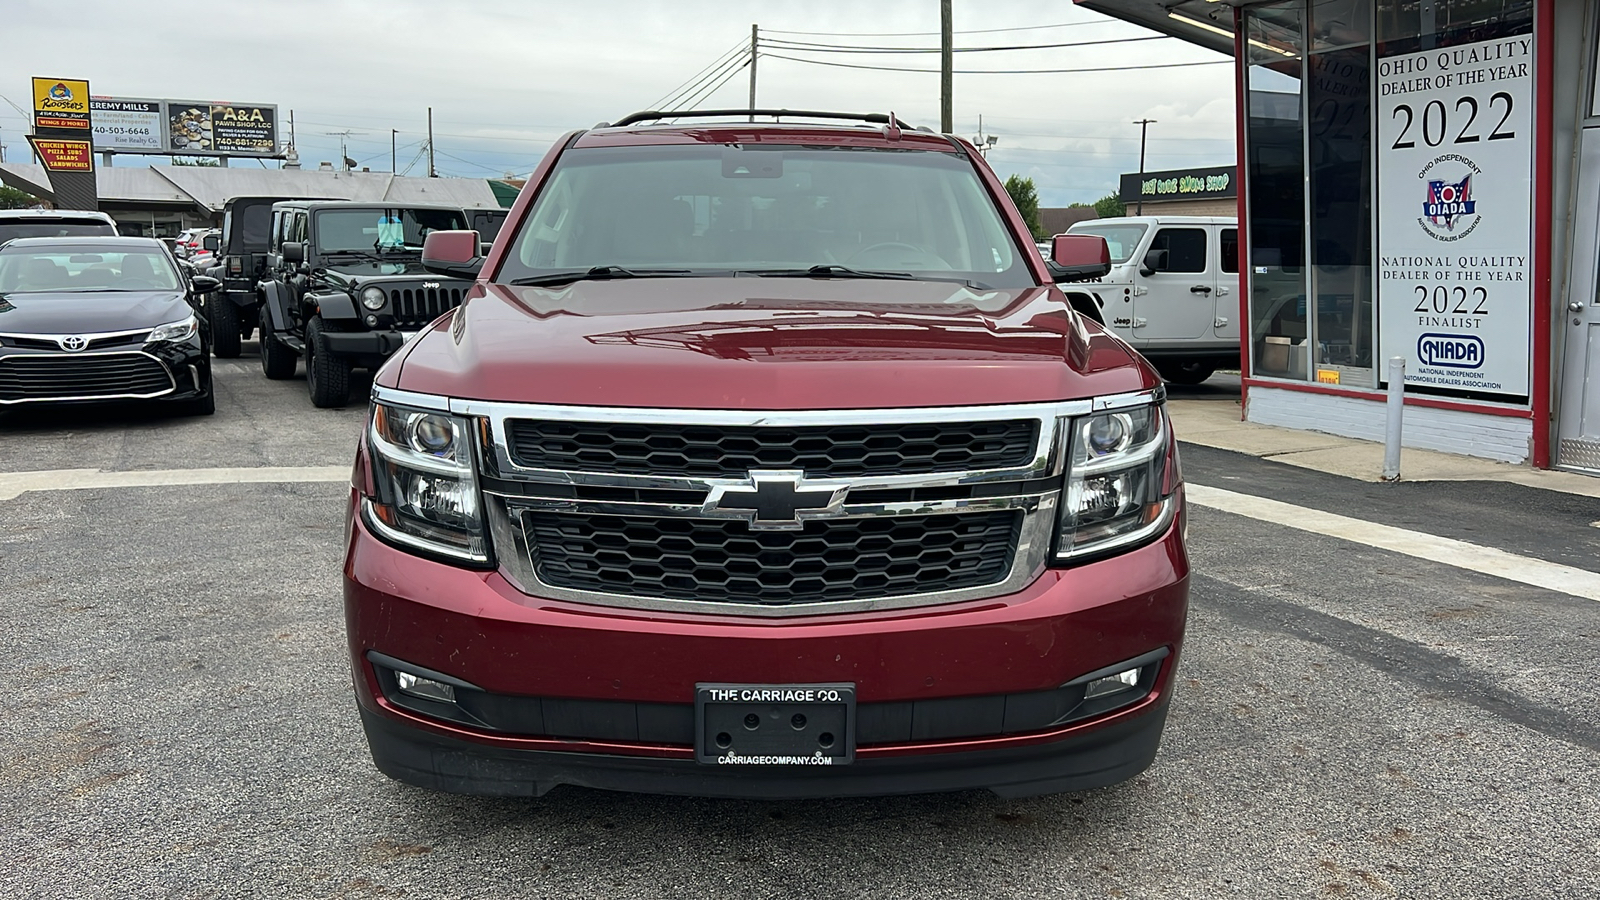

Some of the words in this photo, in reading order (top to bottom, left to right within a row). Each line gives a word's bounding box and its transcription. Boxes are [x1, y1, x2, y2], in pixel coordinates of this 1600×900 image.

[1379, 56, 1428, 77] OHIO
[1437, 39, 1531, 71] QUALITY
[1381, 77, 1432, 96] DEALER
[1435, 73, 1453, 89] OF
[1456, 69, 1485, 86] THE
[1488, 63, 1528, 81] YEAR
[40, 97, 83, 110] Roosters
[90, 101, 120, 110] EREMY
[122, 103, 149, 111] MILLS
[223, 107, 264, 122] A&A
[1391, 91, 1515, 150] 2022
[92, 126, 150, 135] 40-503-6648
[1418, 161, 1434, 179] OHIO
[1434, 153, 1482, 175] INDEPENDENT
[1429, 202, 1466, 215] OIADA
[1417, 217, 1439, 240] AUTOMOBILE
[1439, 234, 1458, 242] DEALERS
[1458, 214, 1482, 239] ASSOCIATION
[1381, 256, 1452, 267] NATIONAL
[1458, 256, 1526, 268] QUALITY
[1383, 270, 1429, 280] DEALER
[1435, 270, 1450, 281] OF
[1456, 271, 1481, 281] THE
[1488, 271, 1523, 282] YEAR
[422, 281, 440, 289] Jeep
[1413, 285, 1488, 315] 2022
[1113, 317, 1131, 325] Jeep
[1418, 316, 1481, 329] FINALIST
[1422, 339, 1478, 364] NIADA
[1418, 367, 1445, 376] NATIONAL
[1446, 370, 1484, 379] INDEPENDENT
[1404, 374, 1437, 384] AUTOMOBILE
[1437, 377, 1461, 386] DEALERS
[1462, 380, 1502, 390] ASSOCIATION
[709, 689, 738, 701] THE
[741, 689, 814, 702] CARRIAGE
[817, 690, 842, 702] CO.
[717, 755, 832, 766] CARRIAGECOMPANY.COM
